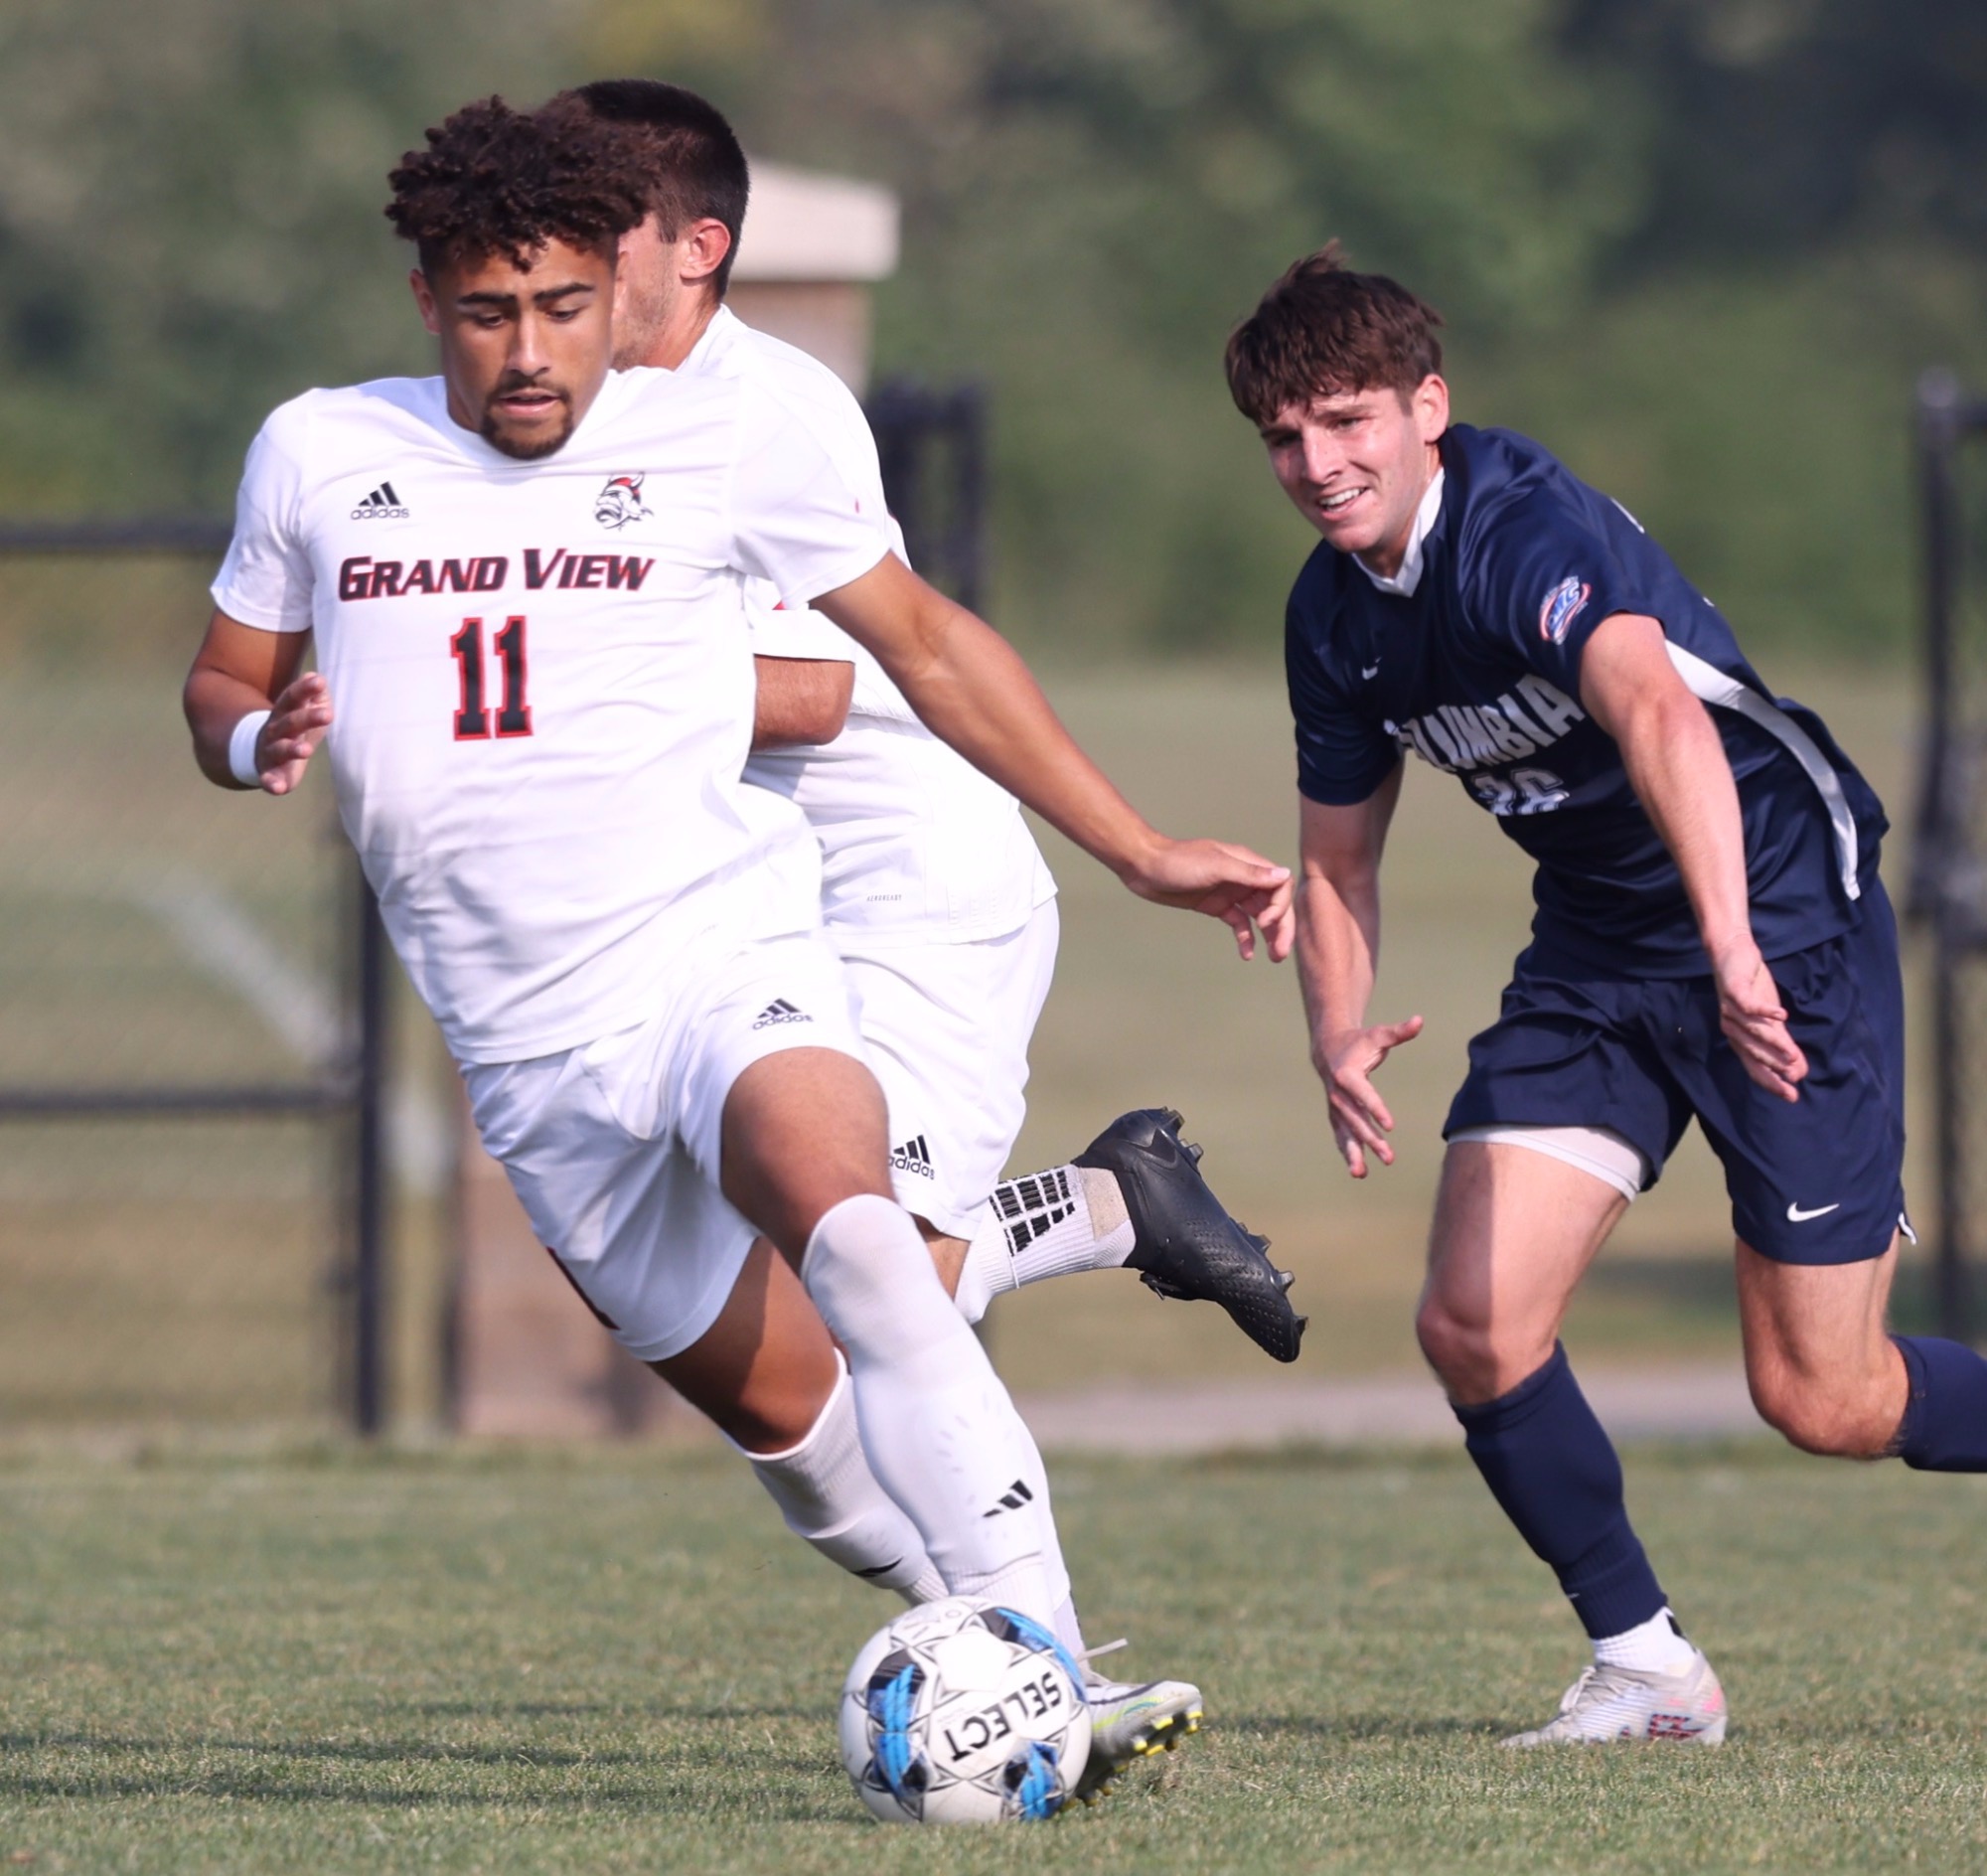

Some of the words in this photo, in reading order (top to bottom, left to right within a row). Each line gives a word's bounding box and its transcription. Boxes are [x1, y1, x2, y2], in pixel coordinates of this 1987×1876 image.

[350, 505, 409, 521] adidas
[338, 555, 509, 602] GRAND
[523, 547, 656, 591] VIEW
[449, 615, 534, 741] 11
[752, 1014, 814, 1030] adidas
[942, 1671, 1063, 1763] SELECT
